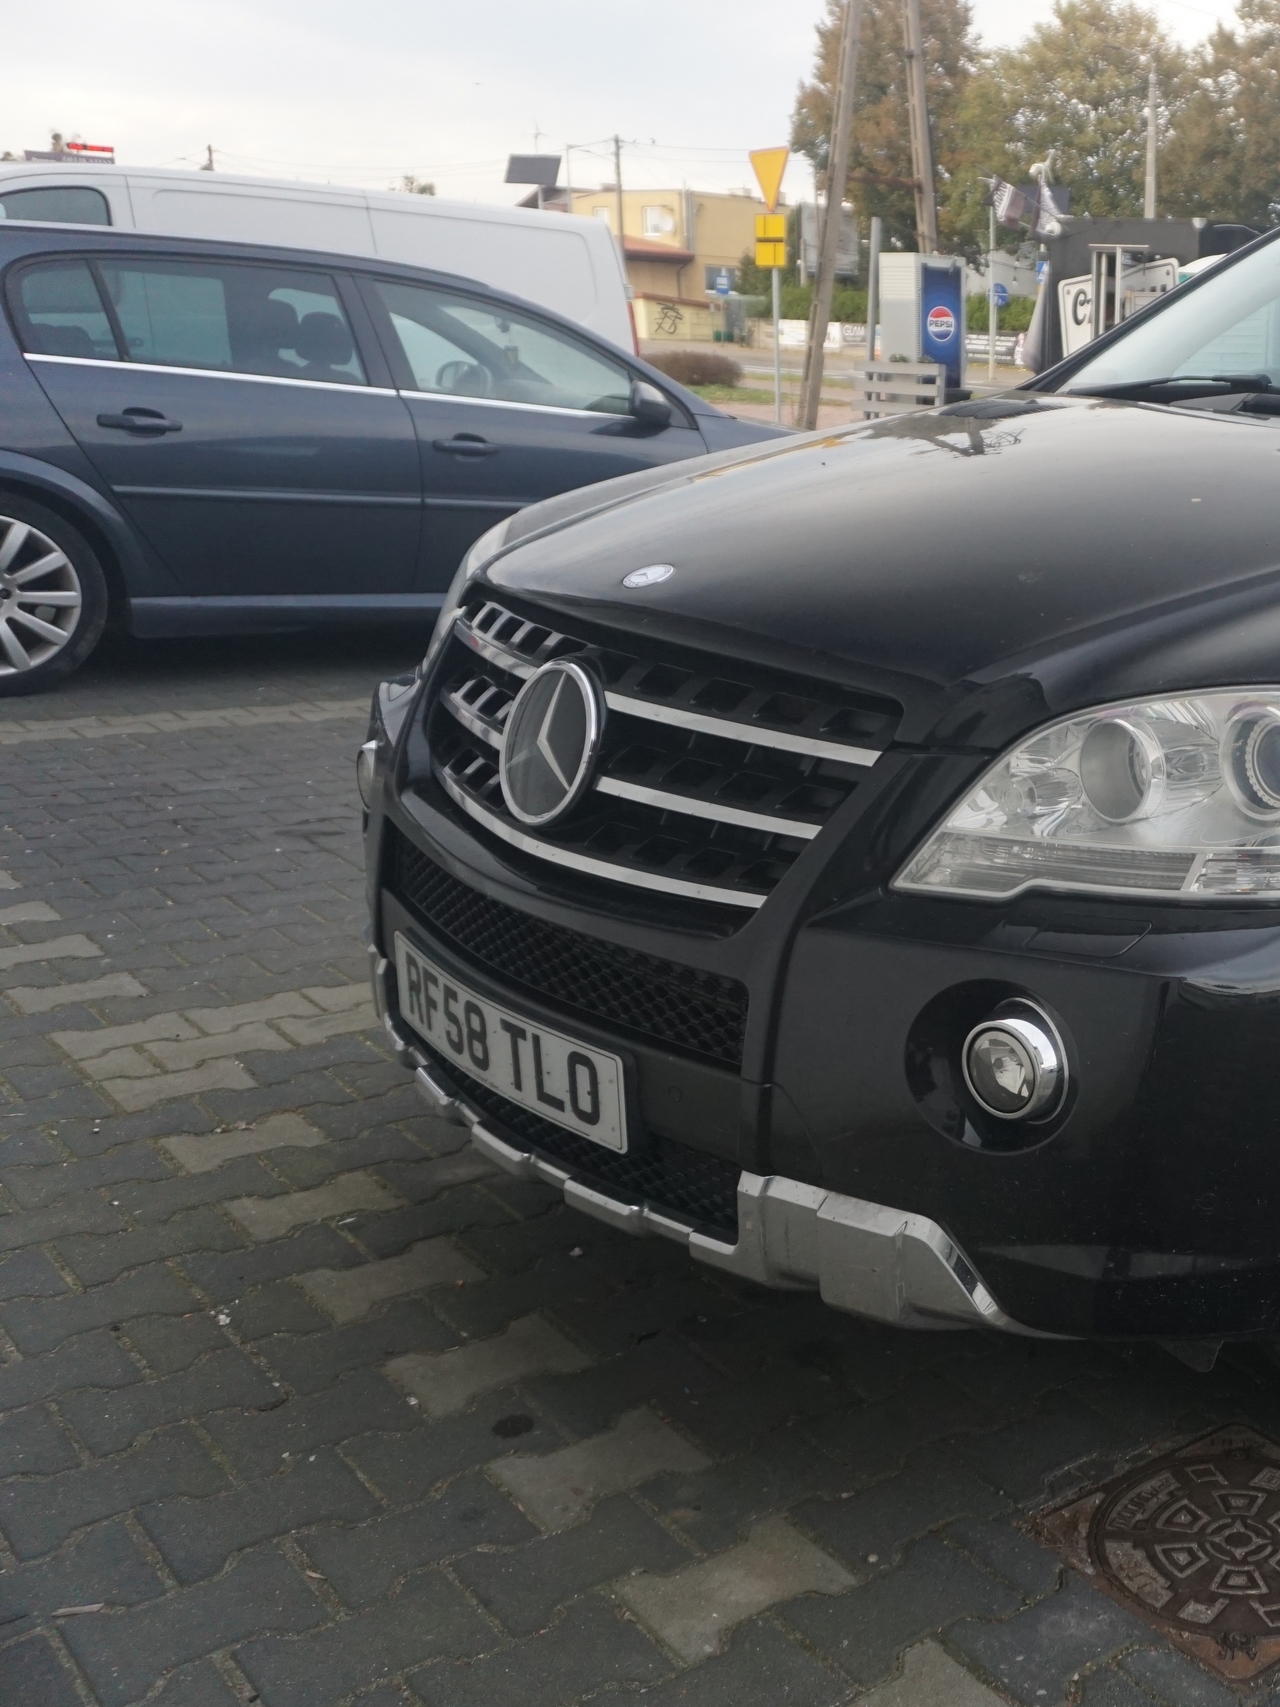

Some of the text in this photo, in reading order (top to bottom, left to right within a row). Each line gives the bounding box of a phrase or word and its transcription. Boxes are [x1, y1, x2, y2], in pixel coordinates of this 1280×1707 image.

[929, 319, 953, 328] PEPSI
[405, 950, 602, 1127] RF58 TLO
